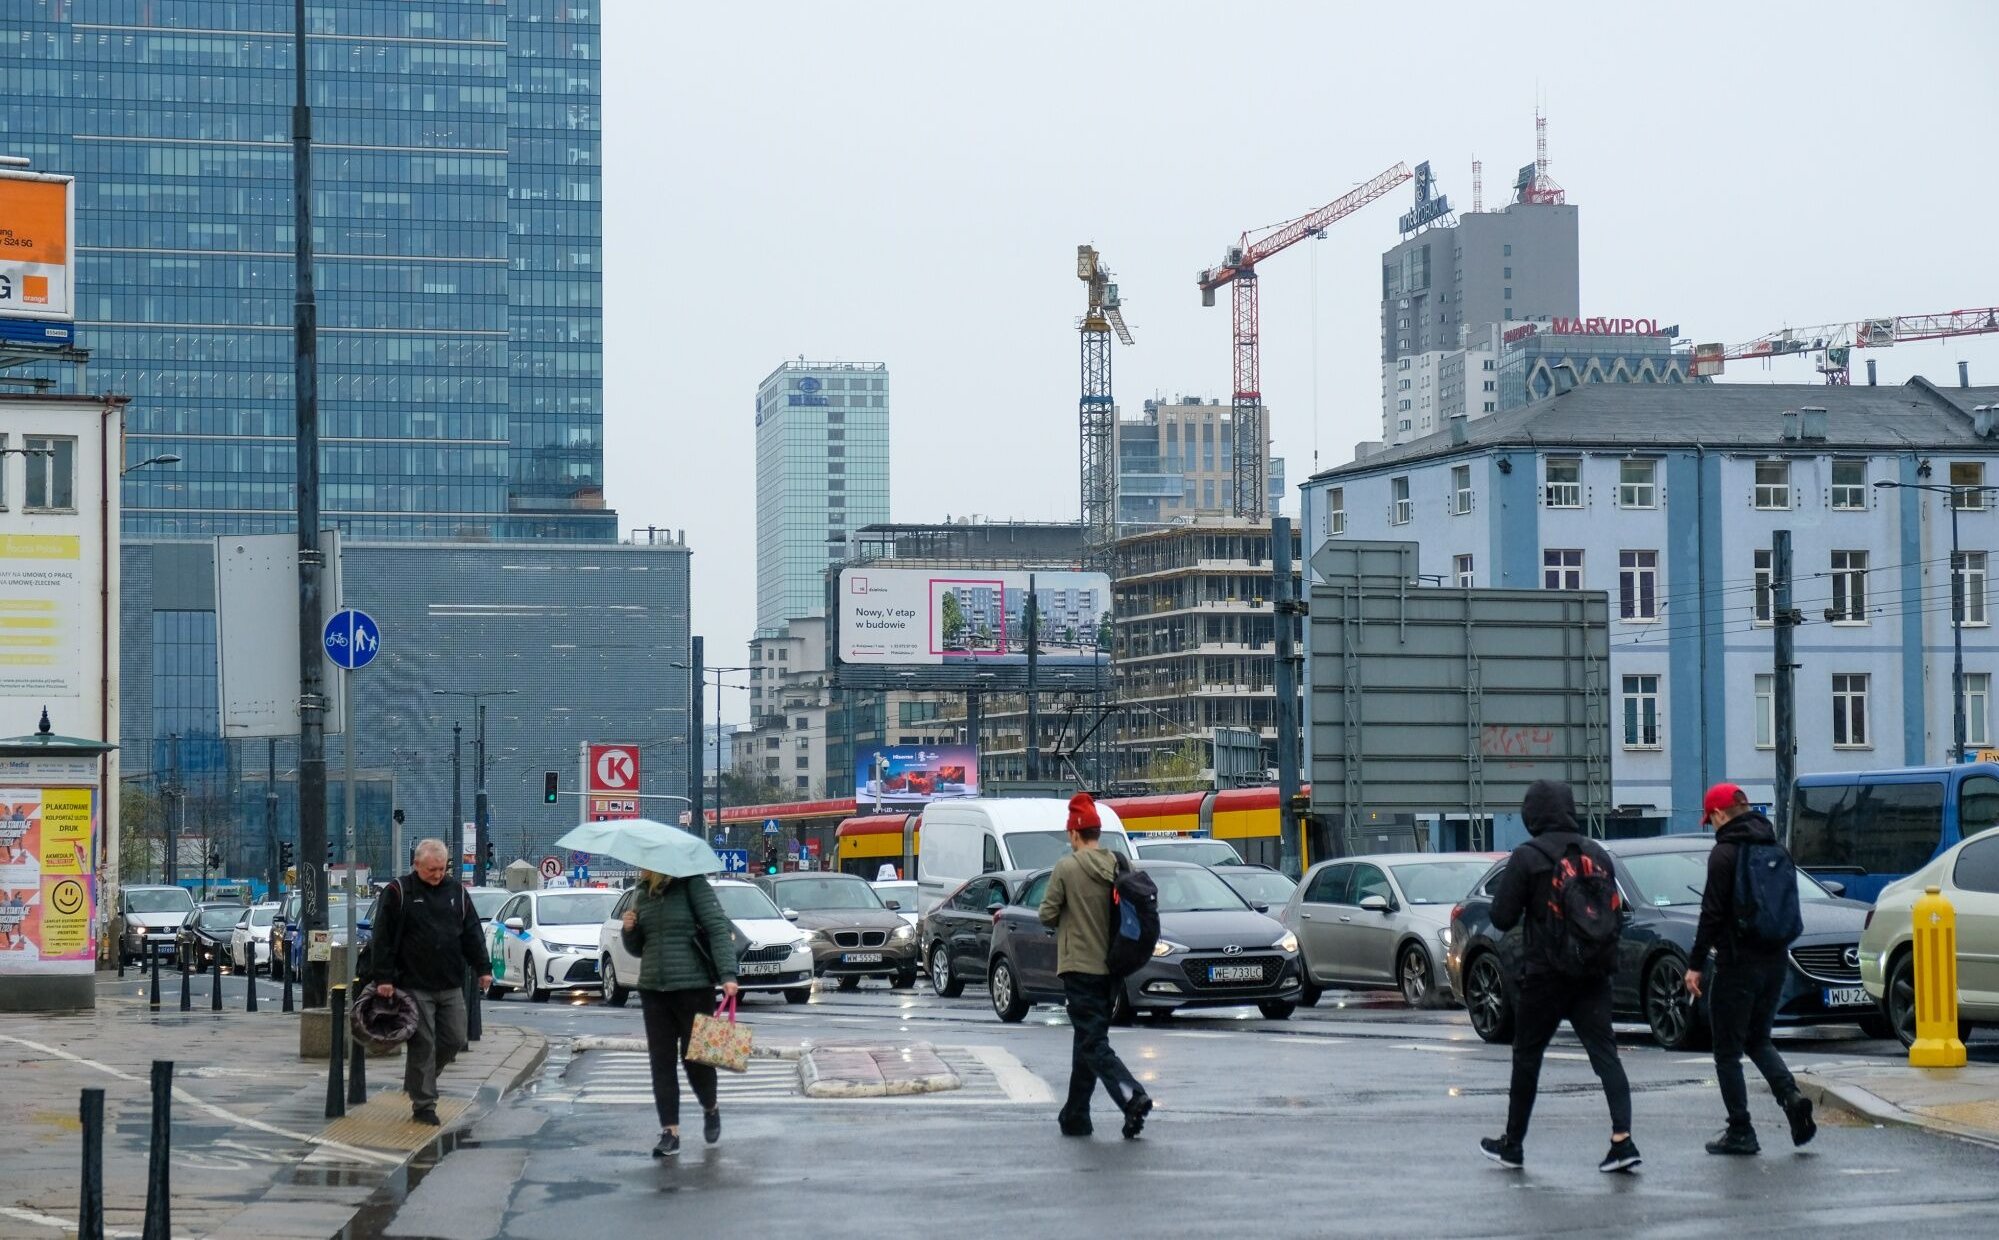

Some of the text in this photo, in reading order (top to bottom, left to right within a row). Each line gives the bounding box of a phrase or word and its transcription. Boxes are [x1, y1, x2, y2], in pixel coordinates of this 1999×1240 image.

[4, 237, 19, 247] S24
[21, 239, 33, 247] 5G
[24, 295, 46, 303] orange
[1552, 317, 1664, 336] MARVIPOL
[856, 608, 916, 618] Nowy, V etap
[866, 620, 906, 628] budowie
[741, 964, 777, 973] WI 479LF
[1215, 967, 1262, 978] WE 733LC
[1832, 990, 1849, 1003] WU
